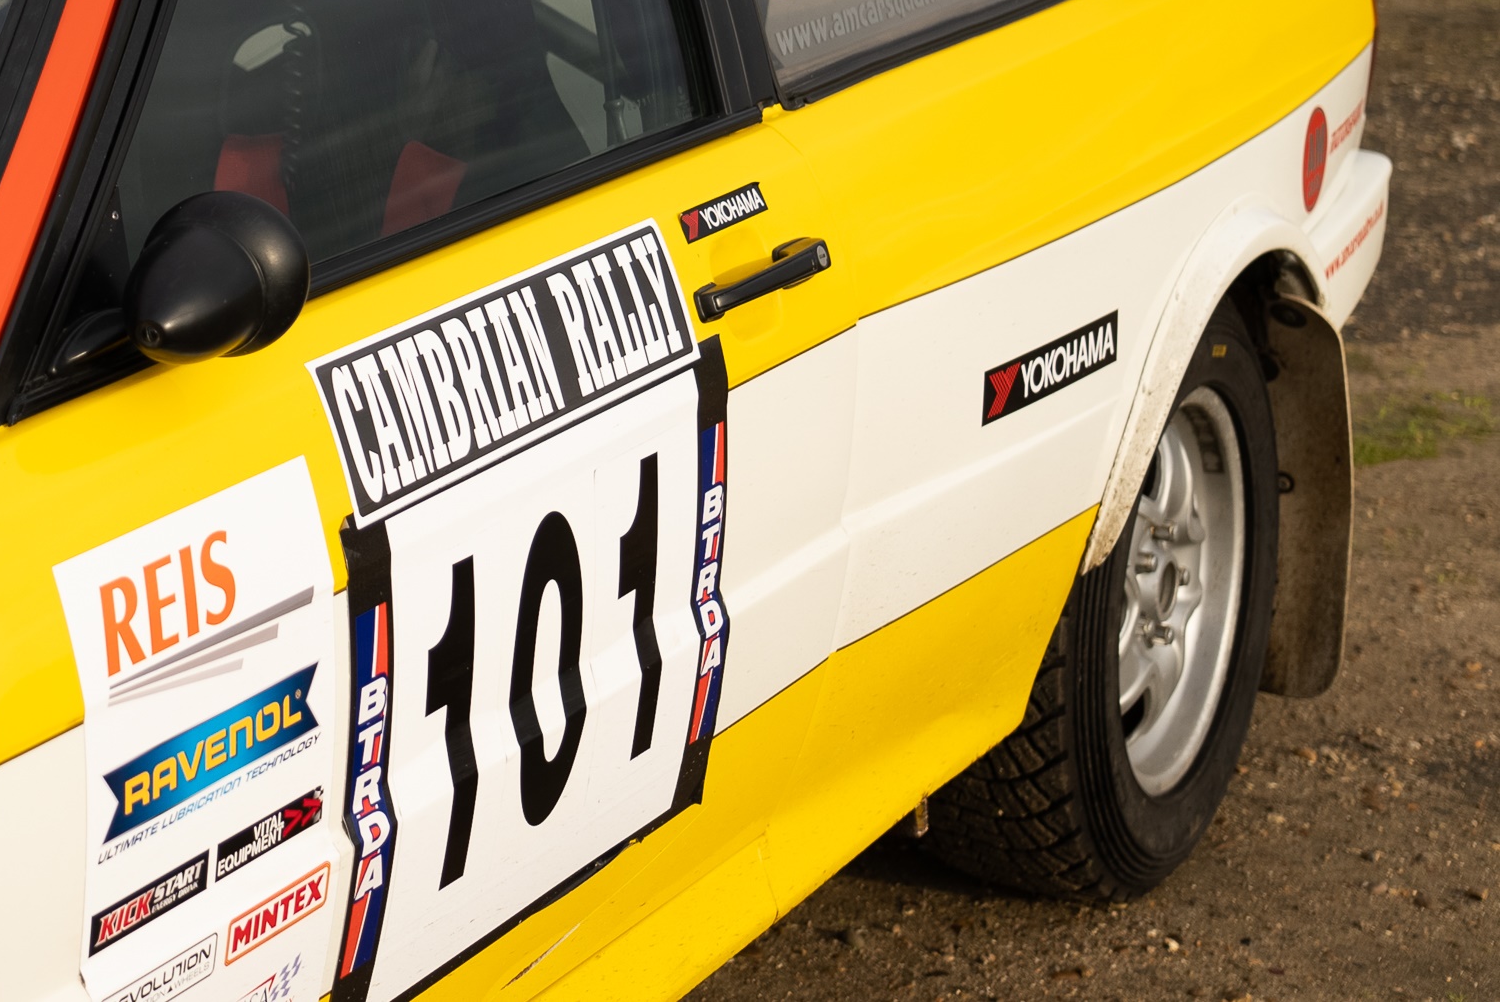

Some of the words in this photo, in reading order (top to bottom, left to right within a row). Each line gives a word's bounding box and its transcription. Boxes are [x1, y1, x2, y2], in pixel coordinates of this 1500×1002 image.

[699, 187, 765, 230] YOKOHAMA
[330, 284, 567, 504] CAMBRIAN
[551, 231, 683, 397] RALLY
[1020, 321, 1115, 399] YOKOHAMA
[99, 529, 236, 678] REIS
[697, 483, 726, 675] BTRDA
[424, 452, 660, 892] 101
[98, 821, 161, 865] ULTIMATE
[161, 777, 242, 829] LUBRICATION
[245, 732, 321, 782] TECHNOLOGY
[124, 694, 302, 816] RAVENOL
[354, 676, 391, 902] BTRDA
[217, 825, 284, 877] EQUIPMENT
[252, 809, 285, 840] VITAL
[97, 887, 155, 947] KICK
[153, 859, 205, 904] START
[231, 872, 325, 954] MINTEX
[113, 943, 212, 1002] EVOLUTION
